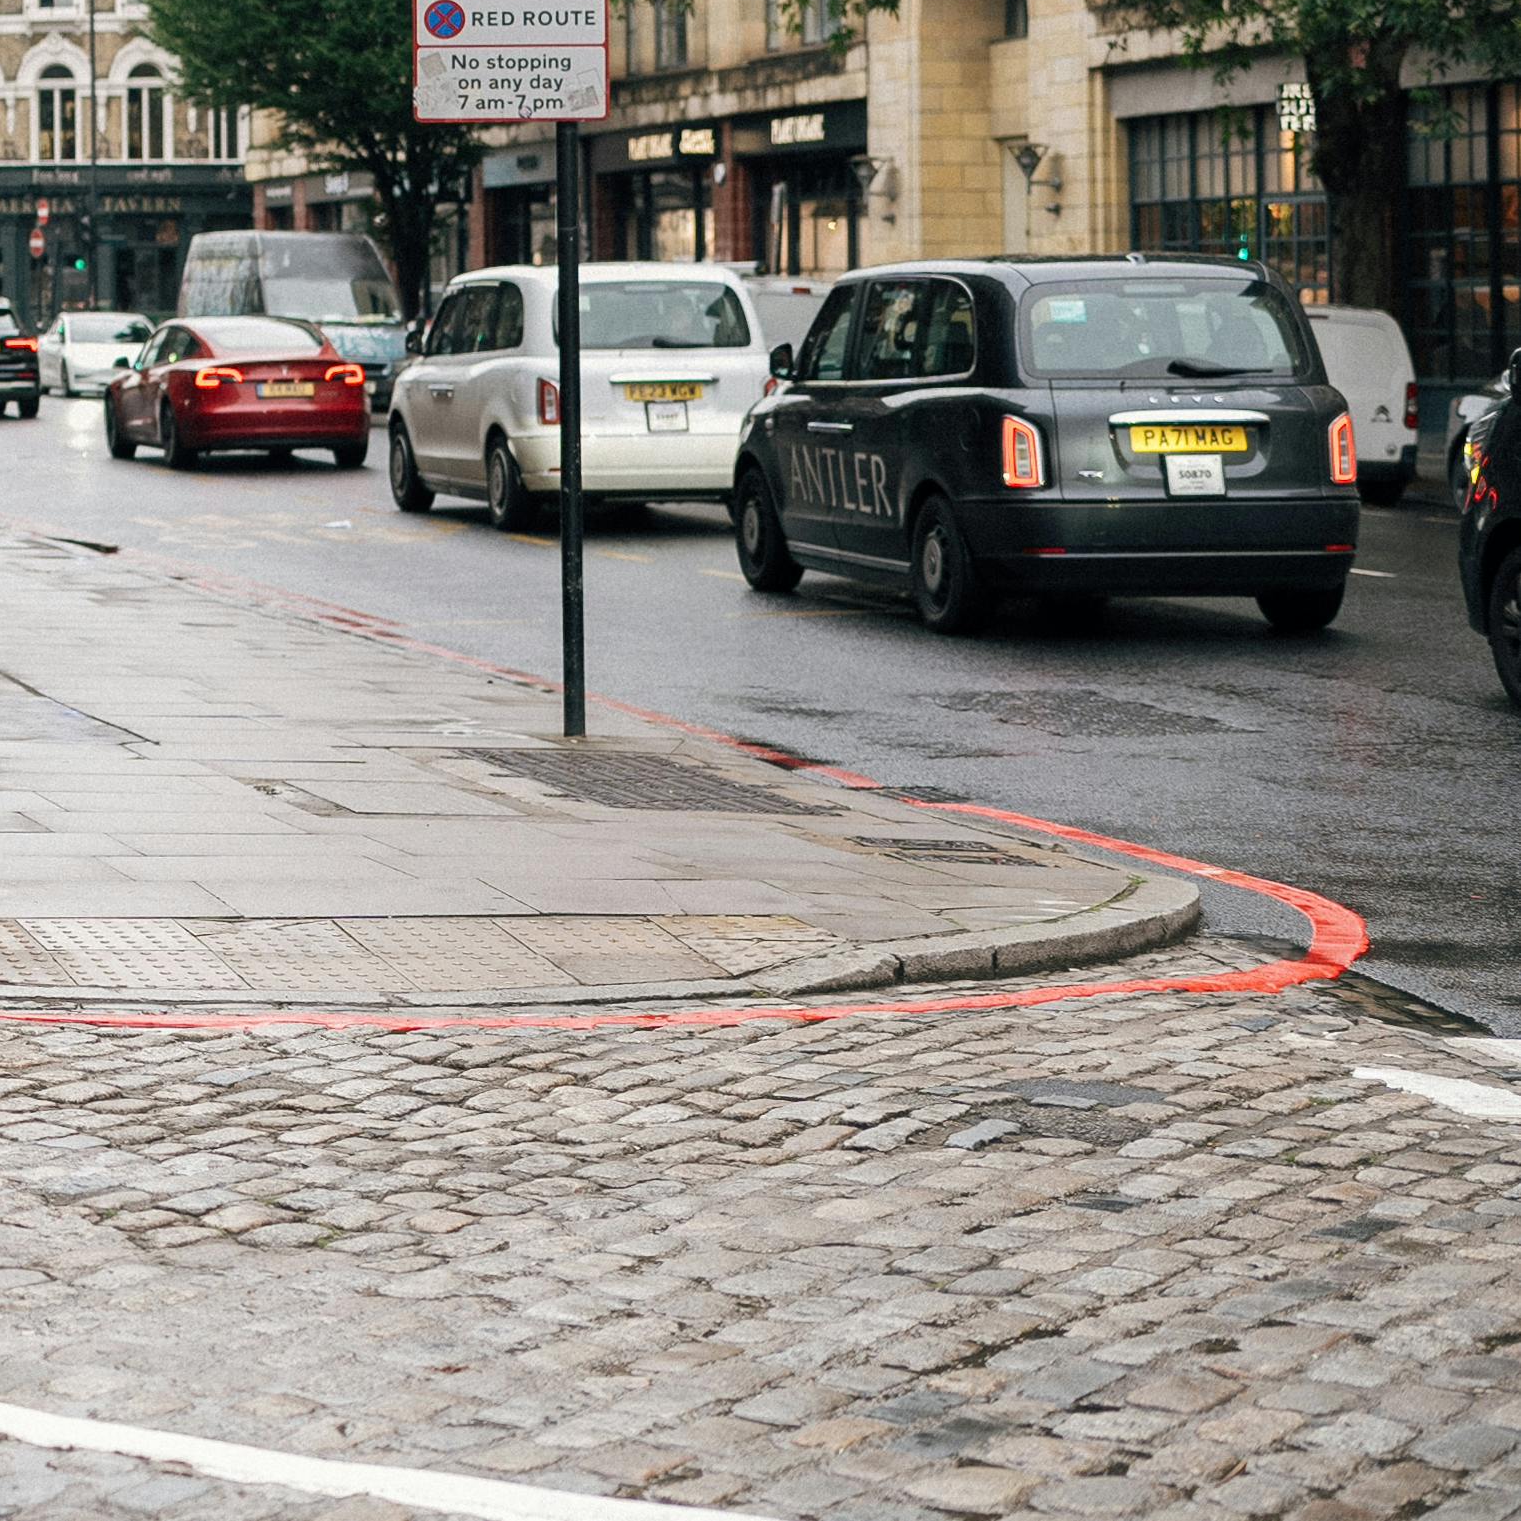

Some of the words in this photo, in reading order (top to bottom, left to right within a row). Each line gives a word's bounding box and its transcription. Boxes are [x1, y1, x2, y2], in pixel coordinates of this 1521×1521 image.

[472, 11, 515, 27] RED
[523, 10, 596, 26] ROUTE
[451, 54, 480, 70] No
[486, 53, 572, 72] stopping
[459, 78, 481, 90] on
[489, 77, 523, 93] any
[529, 74, 564, 92] day
[102, 195, 182, 213] TAVERN
[790, 444, 892, 518] ANTLER
